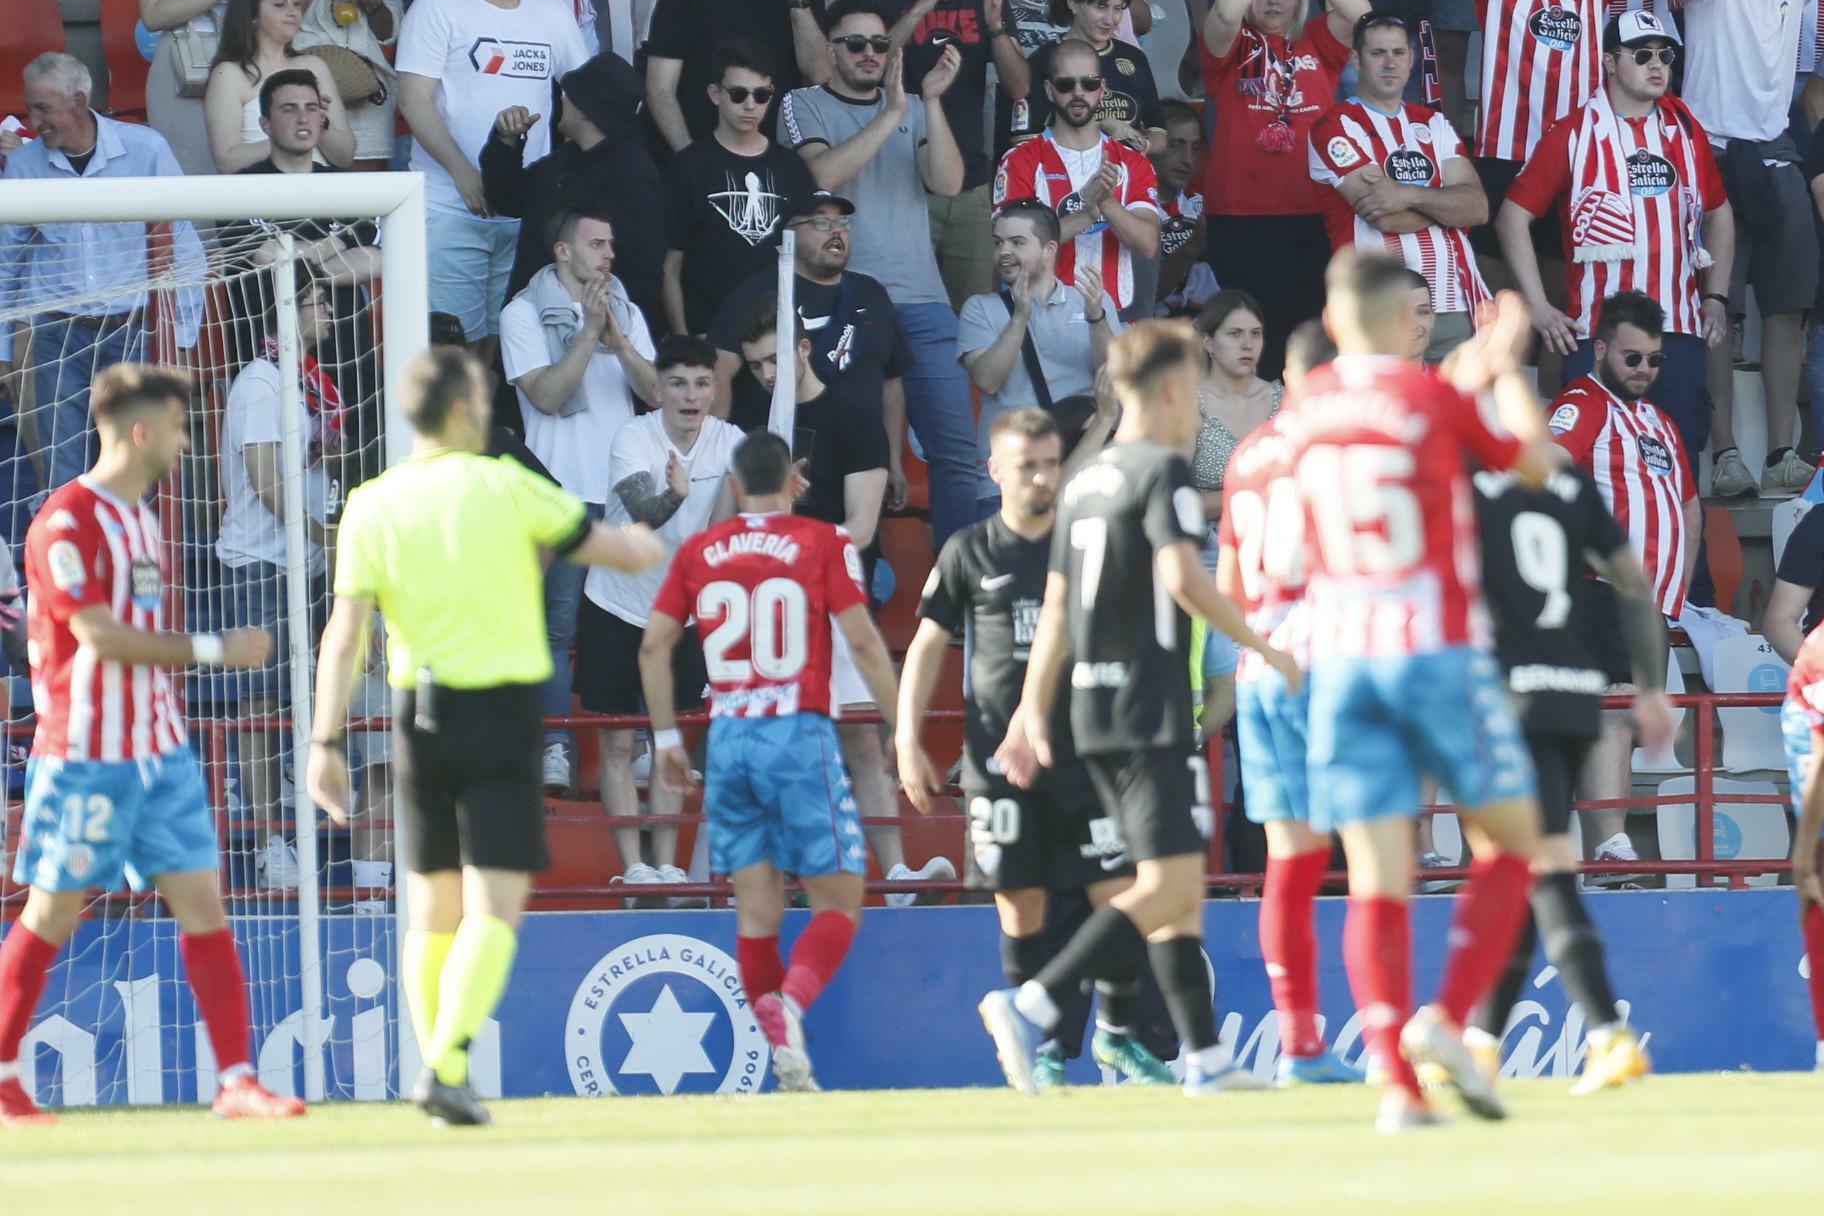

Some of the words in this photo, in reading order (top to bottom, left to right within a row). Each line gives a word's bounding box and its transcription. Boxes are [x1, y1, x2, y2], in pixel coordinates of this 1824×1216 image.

[511, 61, 545, 72] JONES
[512, 49, 547, 60] JACK&
[1300, 444, 1424, 574] 15
[703, 532, 799, 567] CLAVERÍA
[1070, 517, 1108, 610] 7
[1510, 511, 1572, 628] 9
[697, 578, 807, 681] 20
[1758, 644, 1772, 654] 43
[64, 794, 113, 841] 12
[971, 796, 1020, 845] 20
[584, 946, 670, 1010] ESTRELLA
[680, 948, 747, 1010] GALICIA
